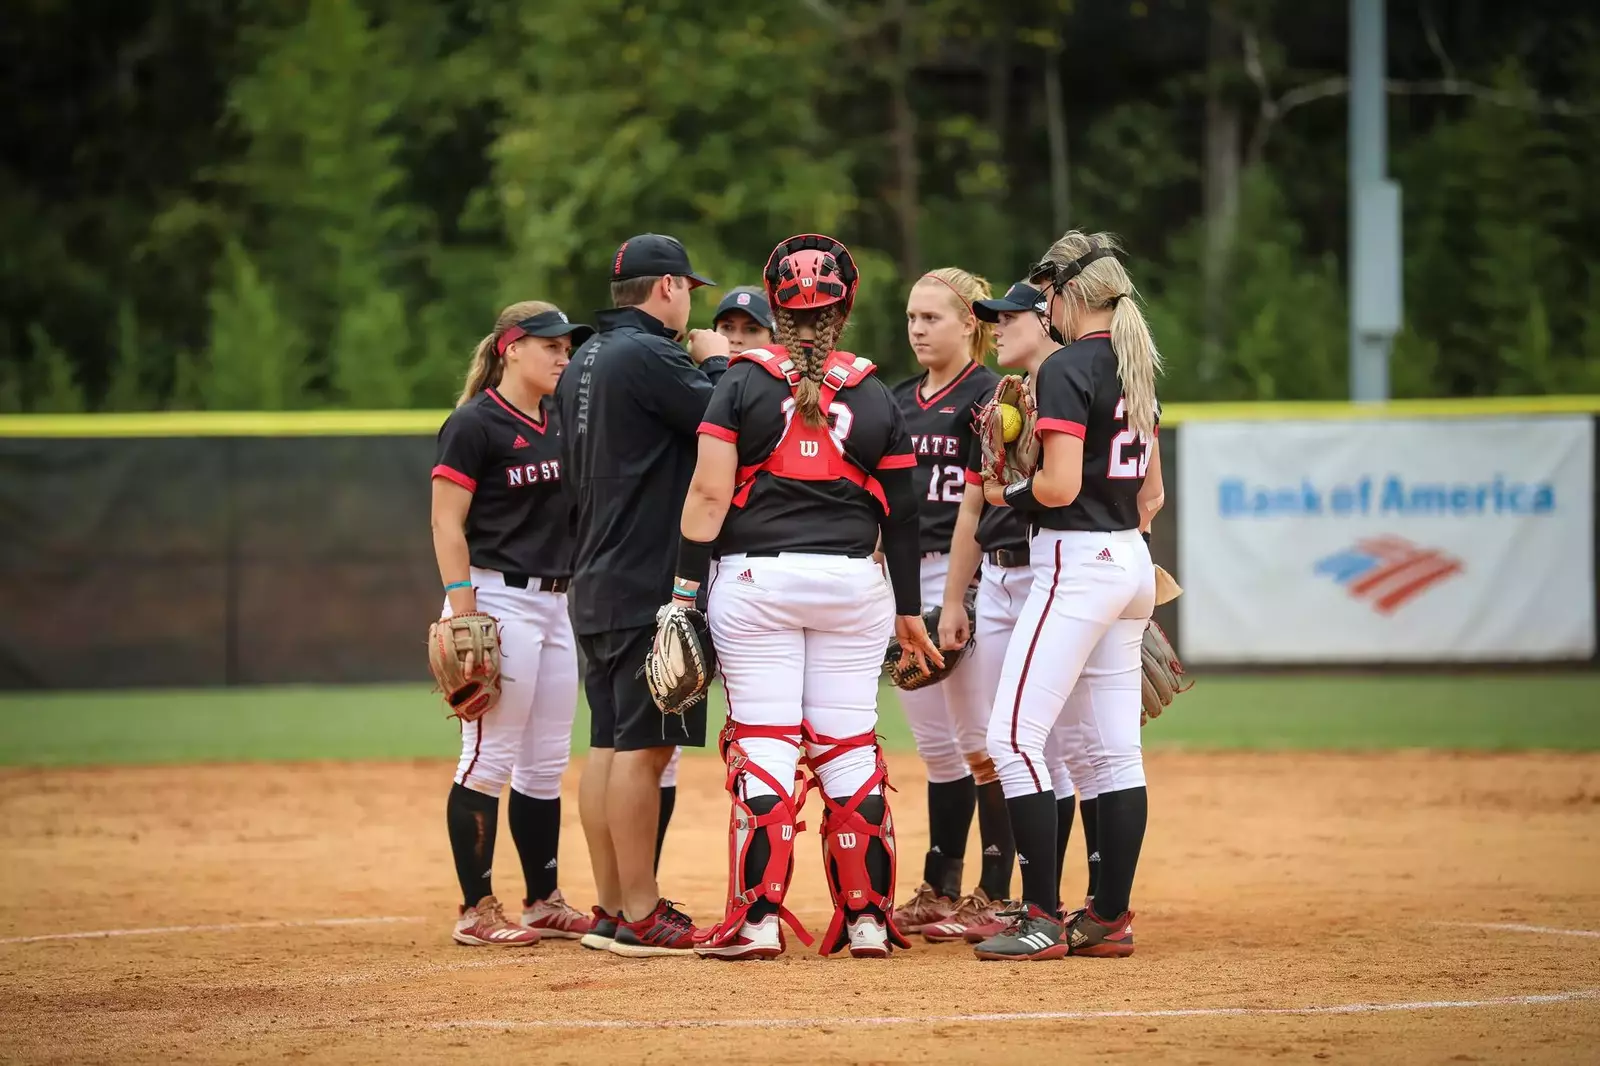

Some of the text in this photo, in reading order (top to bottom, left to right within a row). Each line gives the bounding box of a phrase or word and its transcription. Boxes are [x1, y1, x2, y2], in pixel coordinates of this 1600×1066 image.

[577, 342, 602, 434] NC STATE
[507, 464, 538, 487] NC
[926, 464, 965, 503] 12
[1218, 473, 1556, 517] Bank of America
[653, 660, 663, 688] A2000
